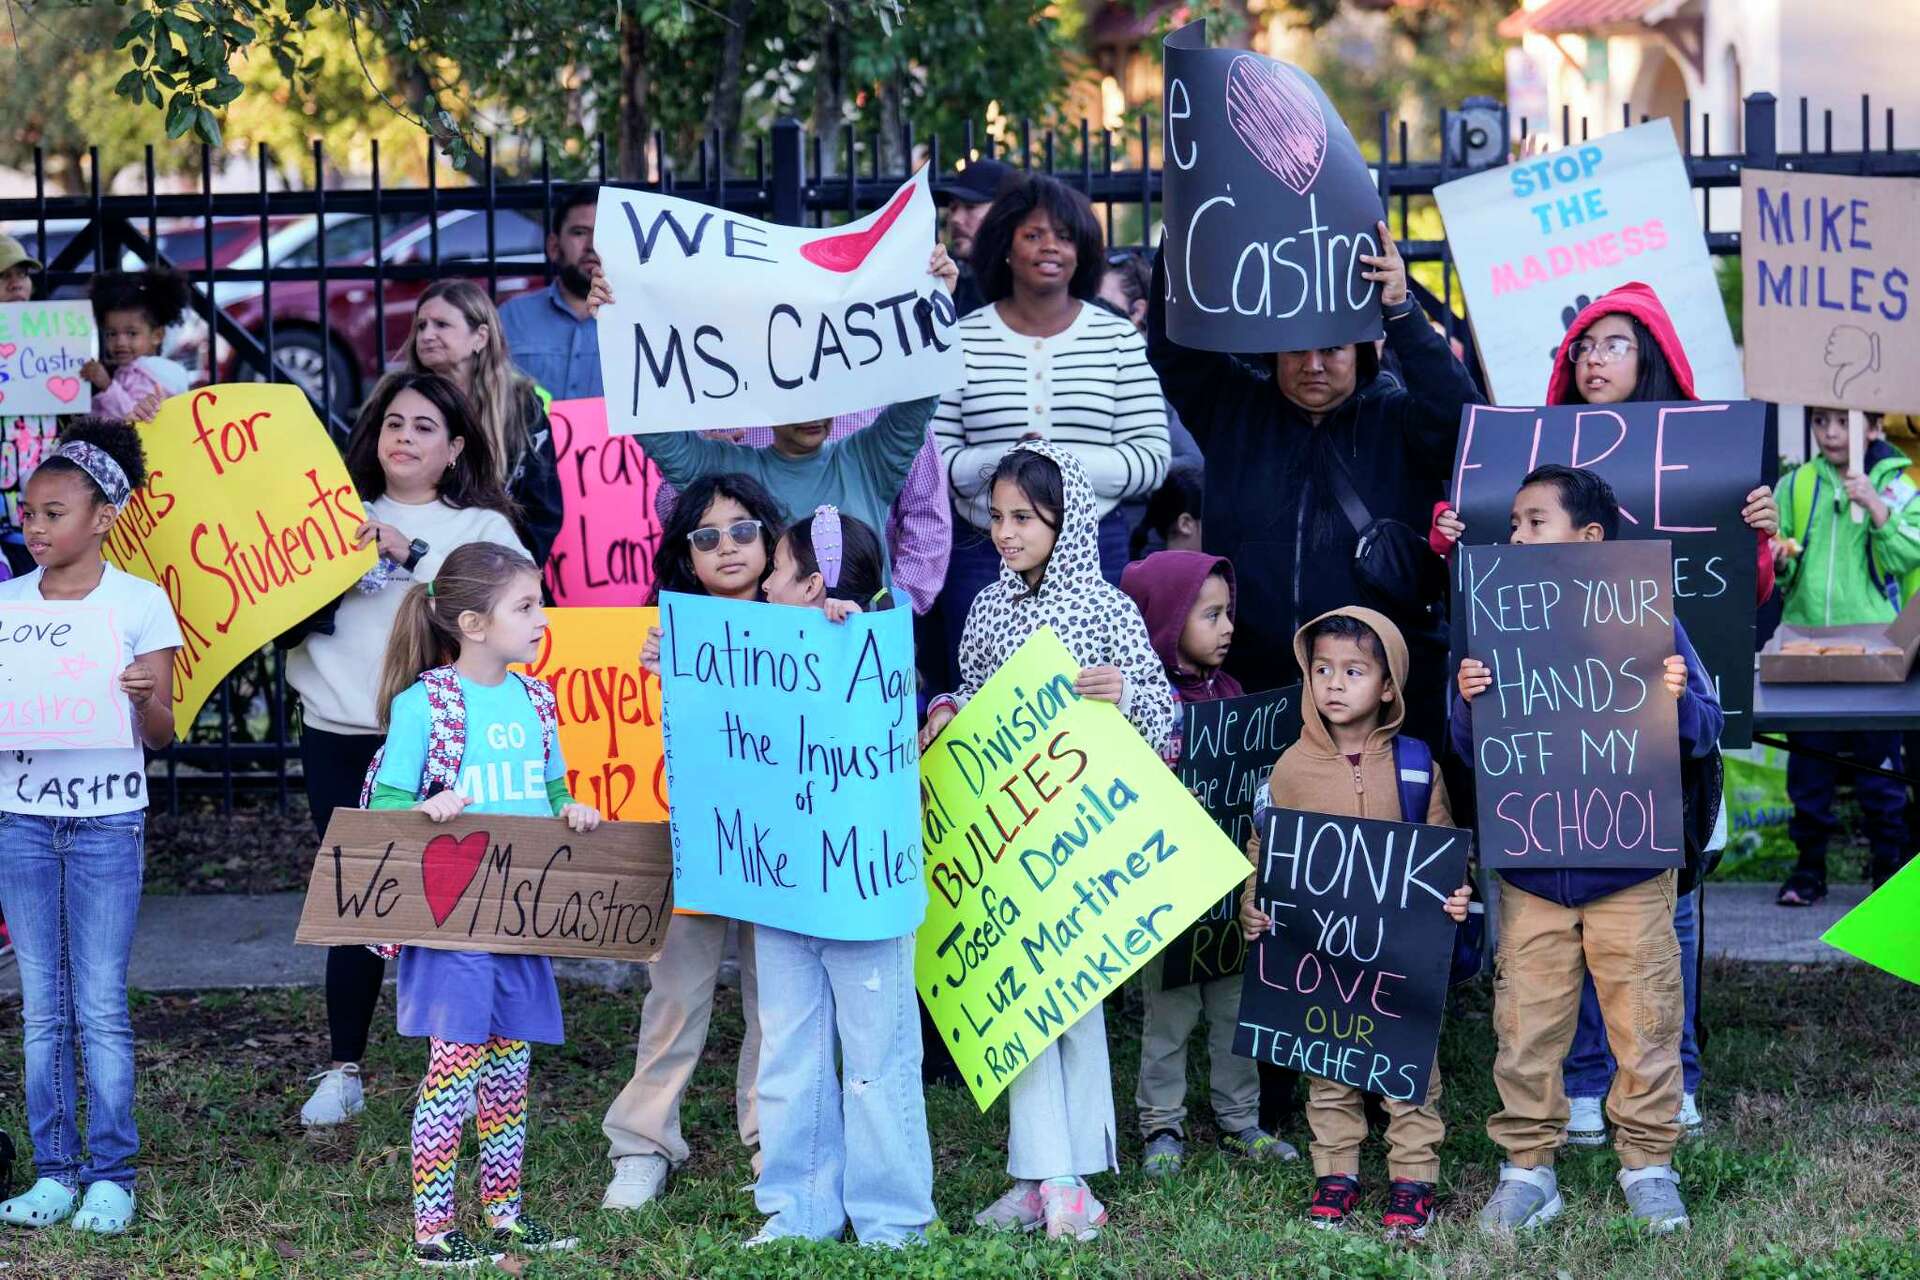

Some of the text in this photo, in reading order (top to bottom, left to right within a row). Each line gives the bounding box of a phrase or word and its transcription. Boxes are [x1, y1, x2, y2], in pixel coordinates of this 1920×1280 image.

[1510, 146, 1603, 198] STOP
[620, 200, 779, 265] WE
[1532, 189, 1608, 235] THE
[1757, 187, 1872, 252] MIKE
[1185, 193, 1378, 318] Castro
[1490, 219, 1669, 297] MADNESS
[1757, 259, 1909, 321] MILES
[21, 311, 90, 336] MISS
[767, 288, 957, 390] CASTRO
[101, 391, 271, 587] rayers for
[1456, 404, 1730, 531] FIRE
[190, 469, 367, 634] Students
[1468, 552, 1560, 636] KEEP
[1573, 578, 1670, 627] YOUR
[669, 603, 821, 692] Latino's
[1493, 647, 1647, 719] HANDS
[525, 625, 662, 759] Prayer
[1190, 697, 1288, 760] We are
[486, 720, 526, 751] GO
[719, 711, 779, 765] the
[946, 673, 1082, 799] Division
[1481, 729, 1638, 776] OFF MY
[796, 781, 815, 815] of
[931, 730, 1089, 910] BULLIES
[1496, 787, 1679, 856] SCHOOL
[332, 841, 402, 919] We
[669, 806, 682, 880] PROUD
[822, 825, 918, 901] Miles
[1263, 814, 1456, 909] HONK
[936, 777, 1139, 990] Josefa Davila
[1260, 897, 1297, 937] IF
[959, 828, 1179, 1039] Luz Martinez
[1312, 908, 1384, 962] YOU
[984, 903, 1174, 1086] Ray Winkler
[1259, 943, 1407, 1018] LOVE
[1239, 1022, 1418, 1100] TEACHERS
[1305, 1006, 1375, 1048] OUR
